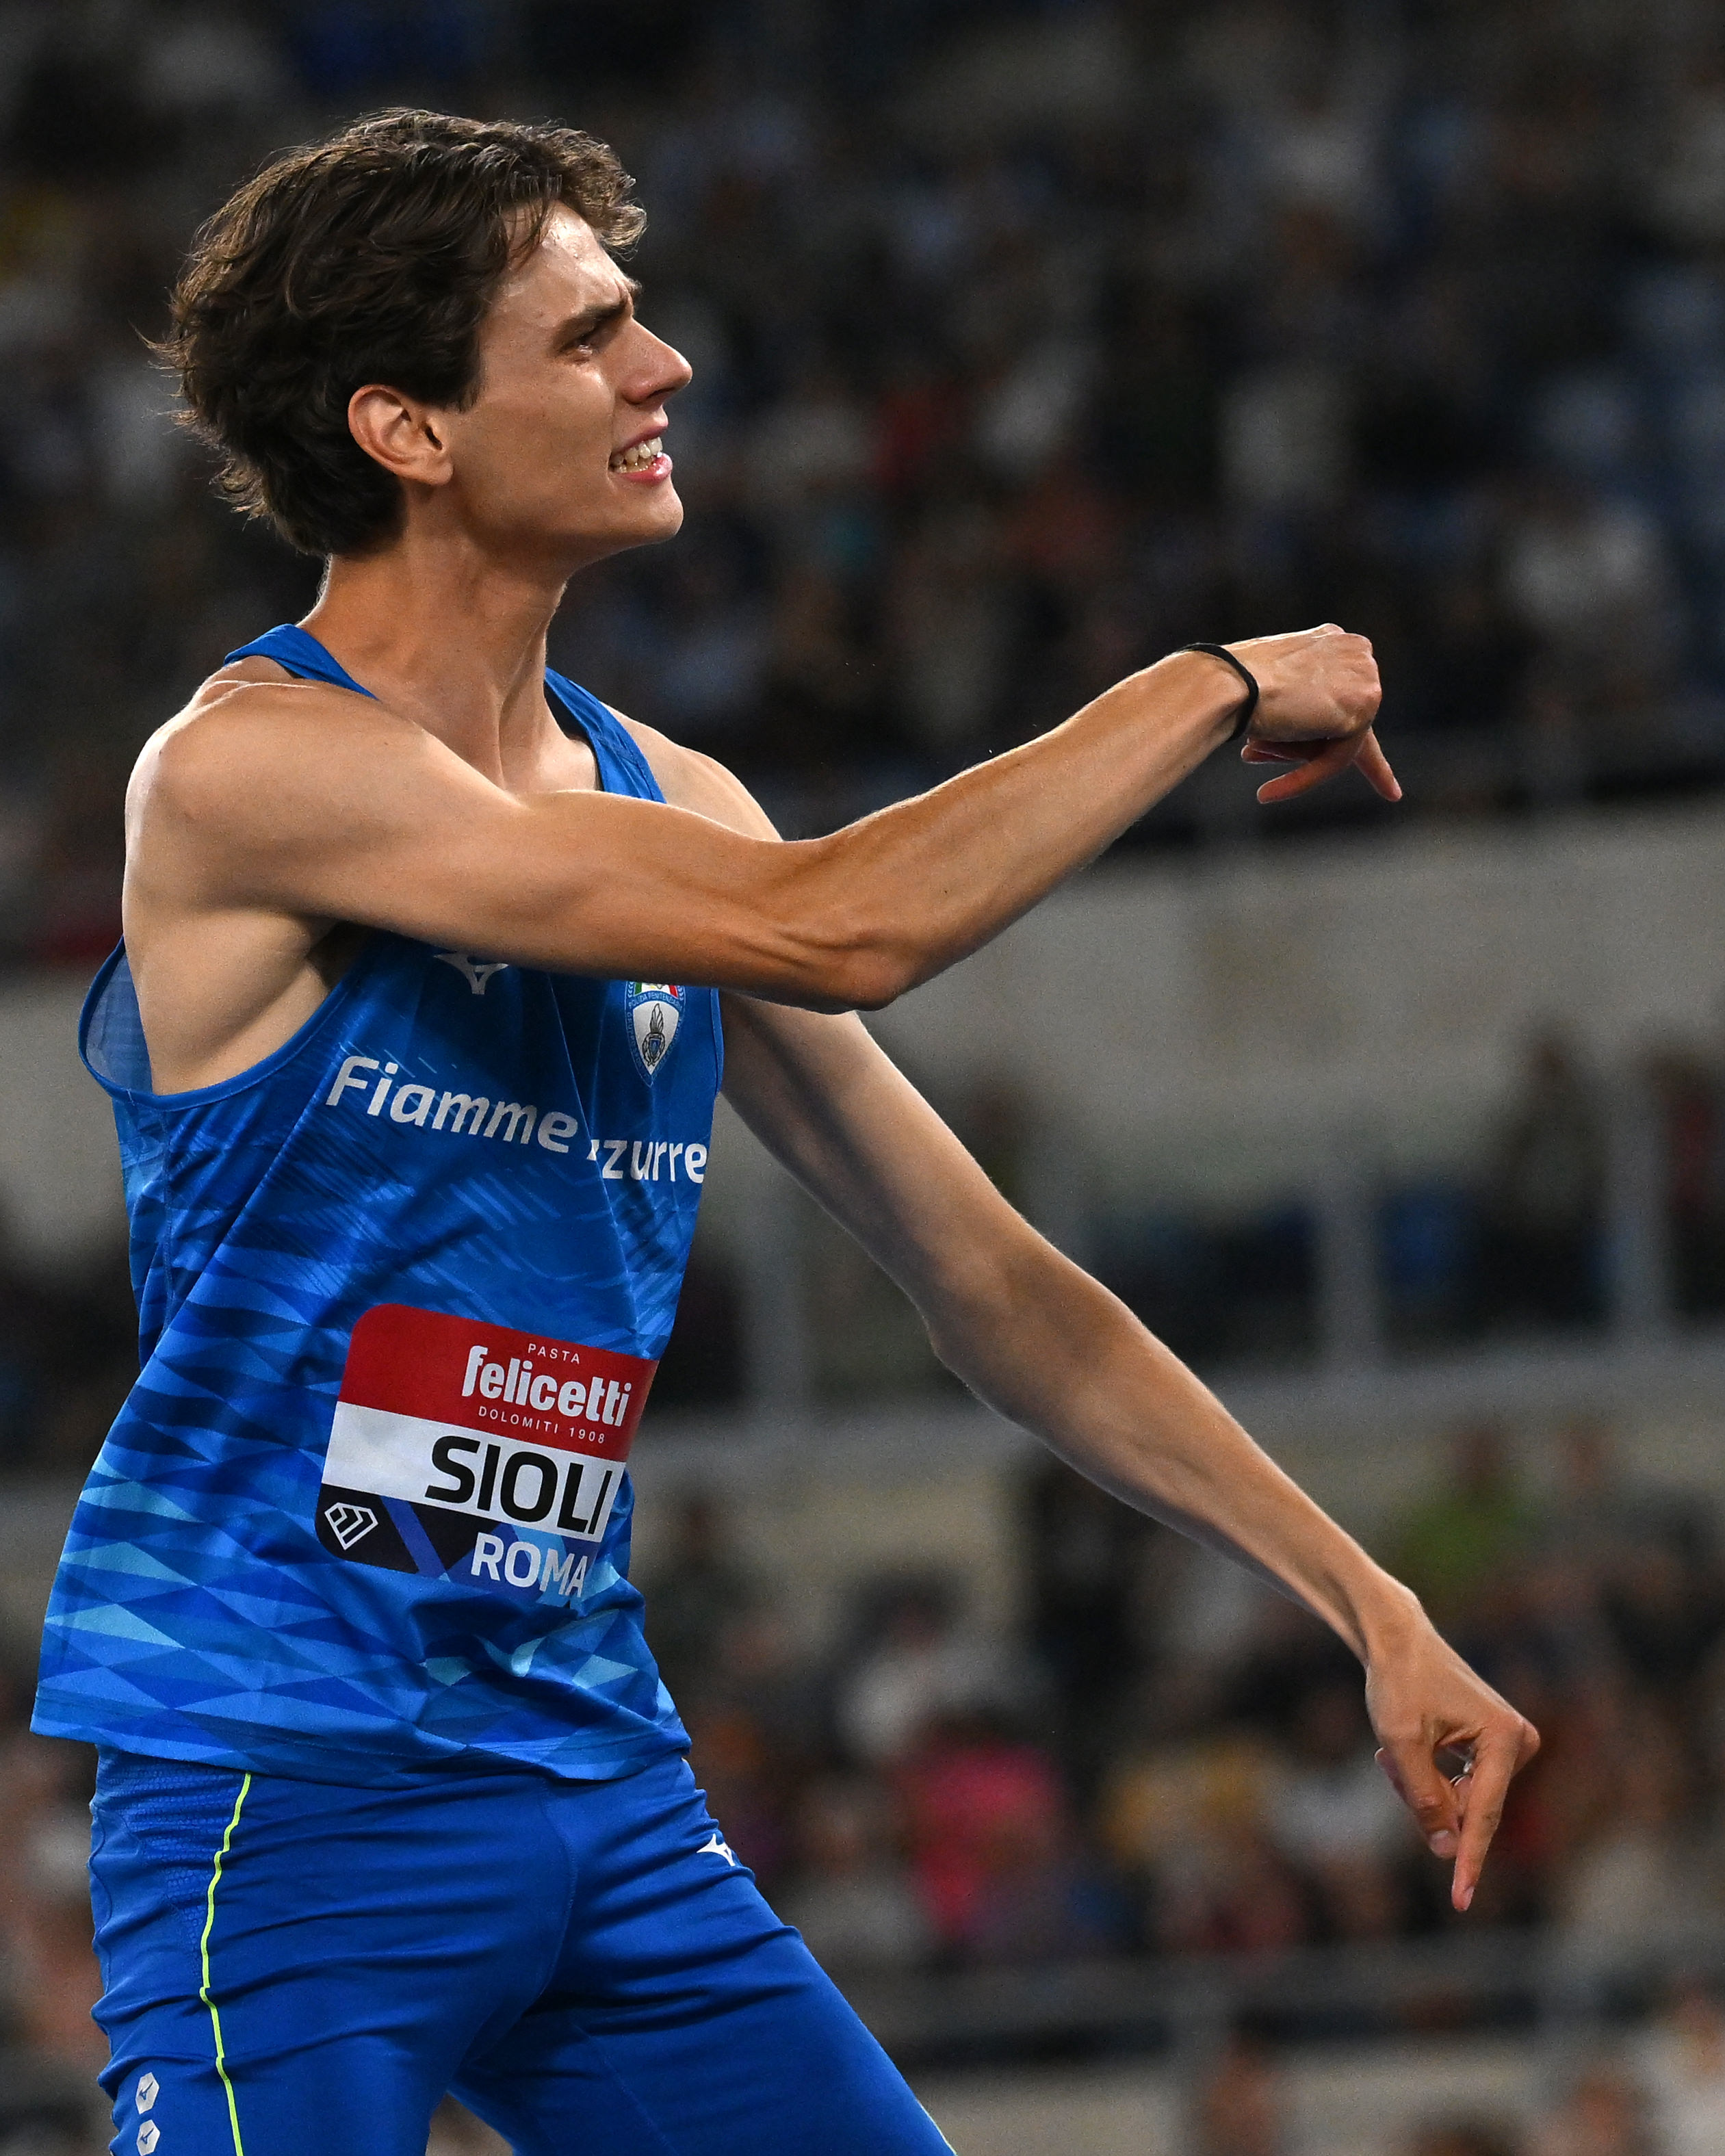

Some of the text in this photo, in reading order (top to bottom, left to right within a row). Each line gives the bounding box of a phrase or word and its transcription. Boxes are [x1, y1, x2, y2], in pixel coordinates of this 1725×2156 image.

[325, 1056, 579, 1153] Fiamme
[586, 1139, 708, 1184] zurre
[462, 1345, 632, 1427] felicetti
[528, 1343, 580, 1364] PASTA
[478, 1406, 606, 1444] DOLOMITI 1908
[424, 1436, 612, 1535] SIOLI
[471, 1532, 588, 1598] ROMA
